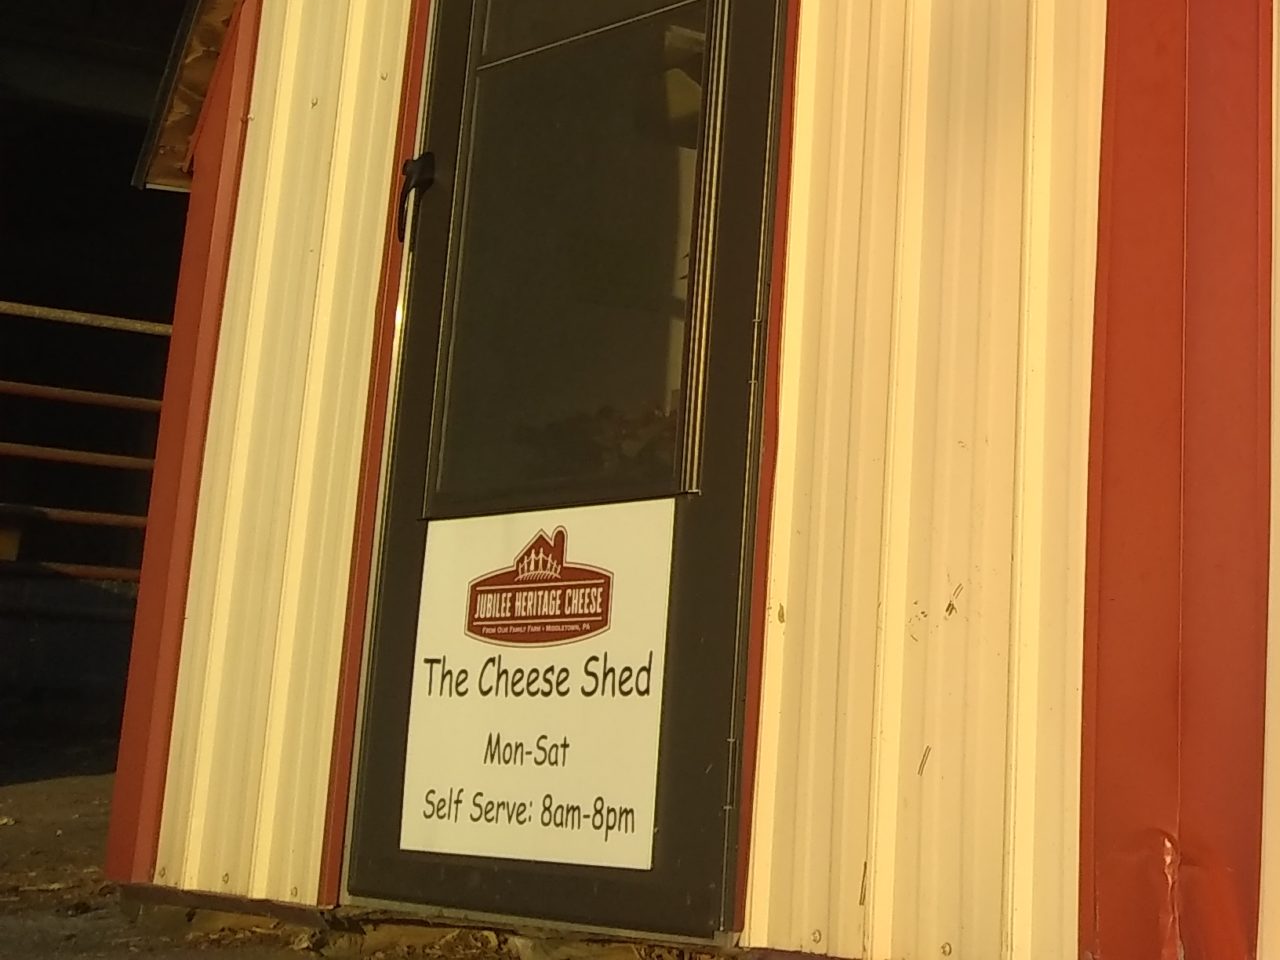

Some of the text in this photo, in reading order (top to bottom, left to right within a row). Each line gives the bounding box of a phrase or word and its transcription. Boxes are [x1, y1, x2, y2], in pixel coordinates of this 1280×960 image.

[473, 587, 603, 619] JUBILEE HERITAGE CHEESE
[423, 650, 654, 698] The Cheese Shed
[483, 732, 571, 768] Mon-Sat
[422, 787, 636, 842] Self Serve: 8am-8pm
